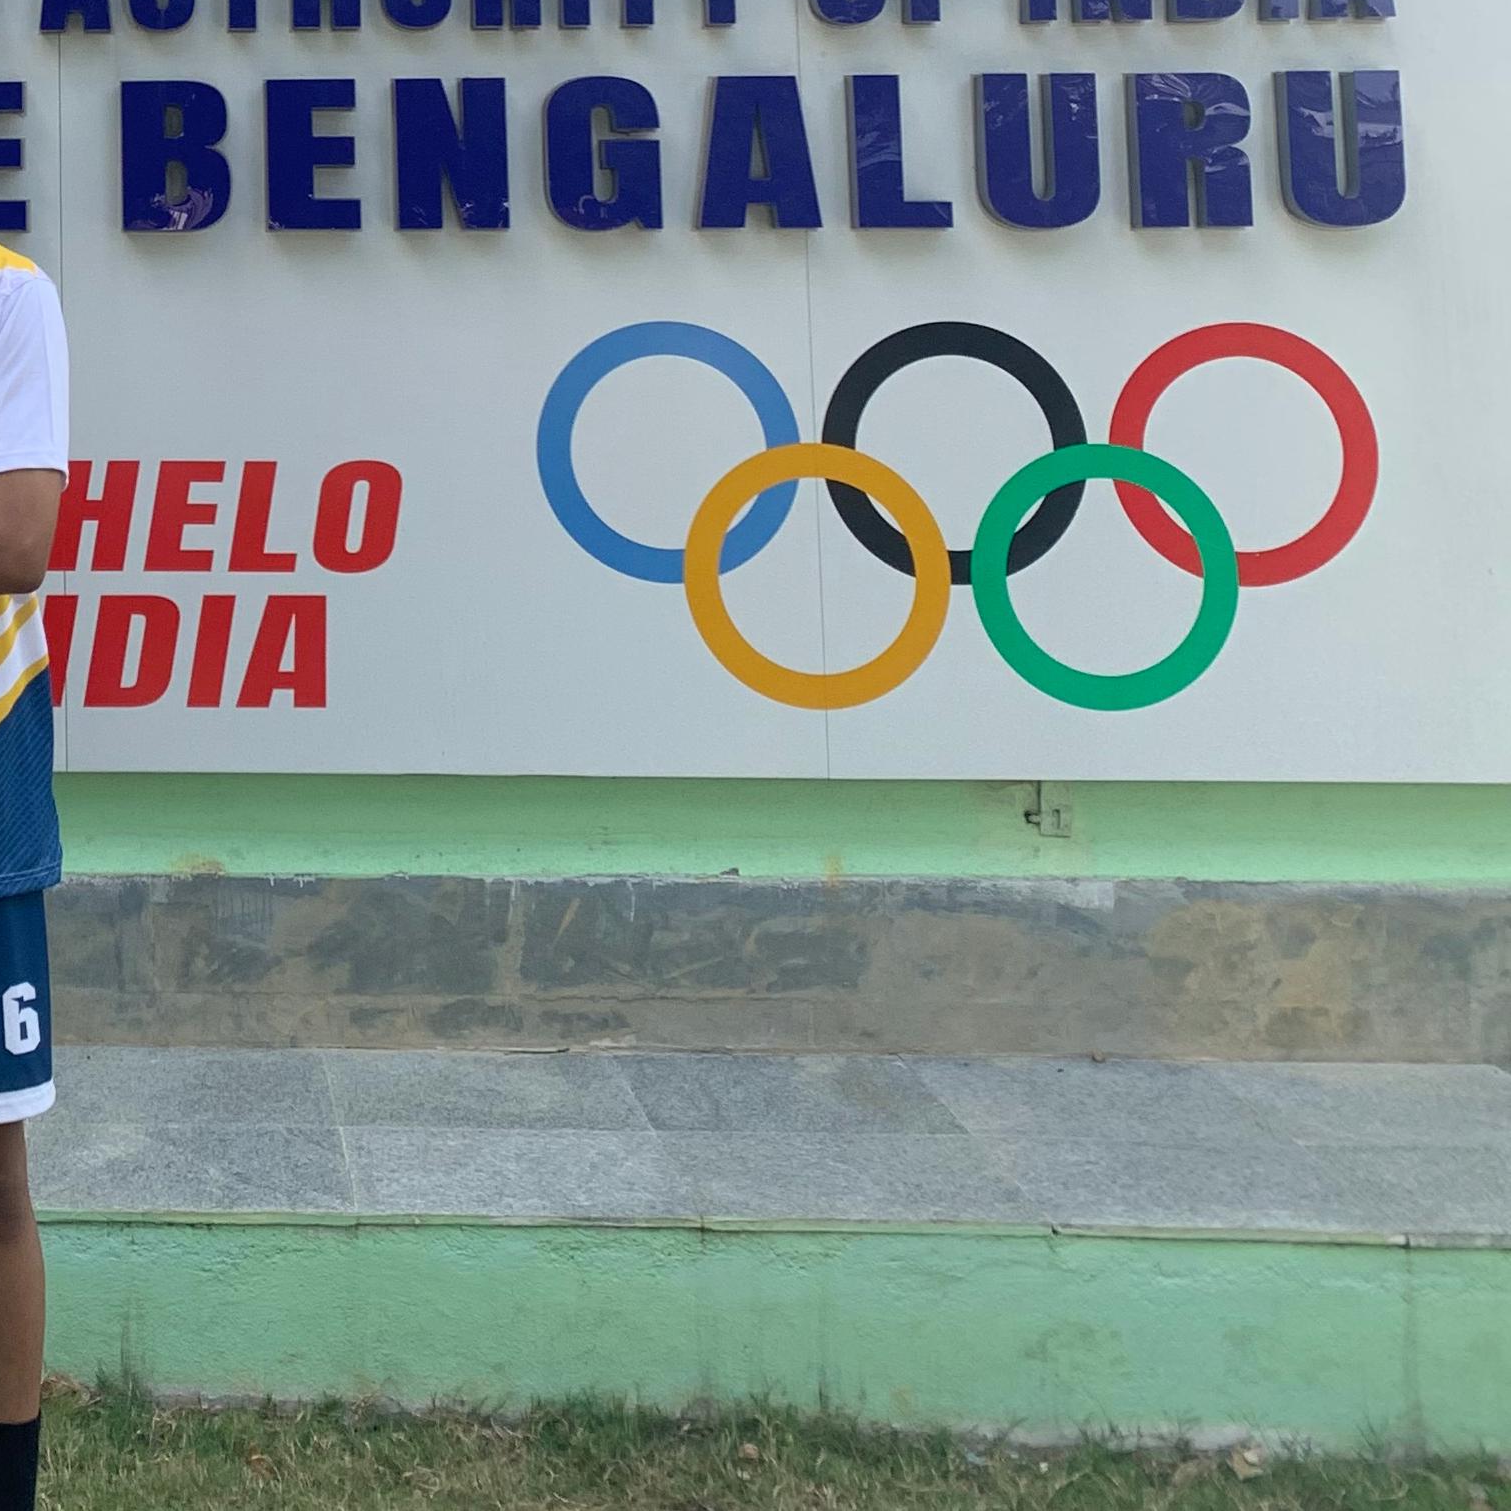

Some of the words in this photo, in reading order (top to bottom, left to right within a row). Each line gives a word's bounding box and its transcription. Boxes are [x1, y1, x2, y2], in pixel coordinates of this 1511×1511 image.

[120, 69, 1406, 232] BENGALURU
[46, 459, 402, 573] HELO
[41, 594, 327, 708] DIA
[2, 982, 41, 1055] 6
